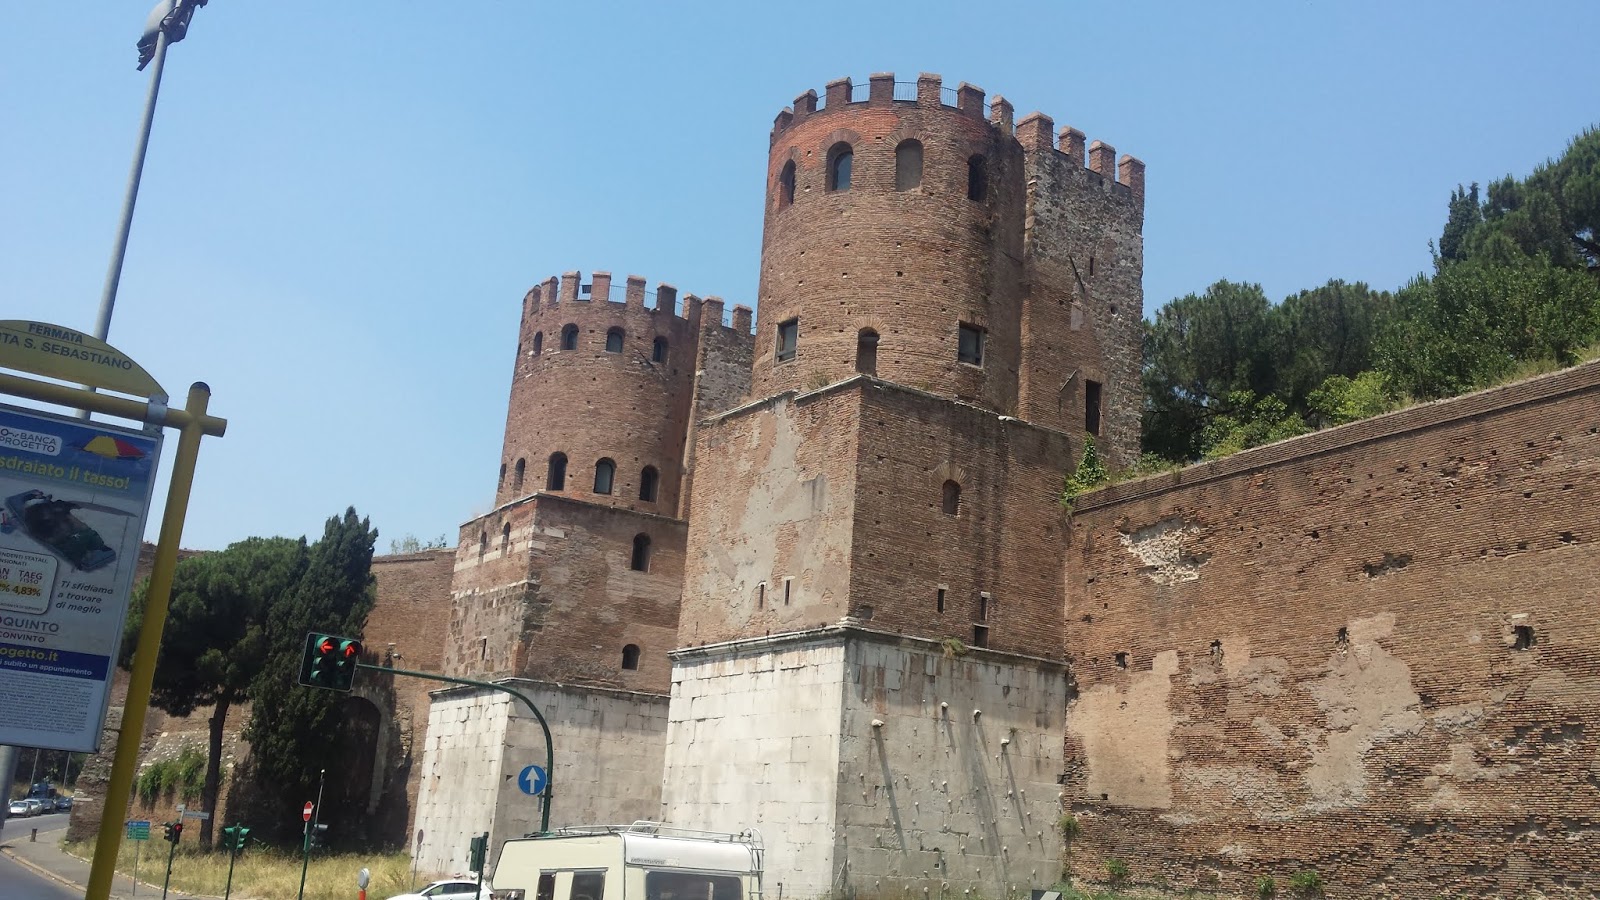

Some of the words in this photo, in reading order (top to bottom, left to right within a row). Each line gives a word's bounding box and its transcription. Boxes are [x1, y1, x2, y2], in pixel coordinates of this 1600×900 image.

[28, 323, 83, 344] FERMATA
[0, 332, 19, 346] TA
[24, 338, 36, 350] S.
[41, 341, 132, 370] SEBASTIANO
[0, 436, 55, 452] PROGETTO
[20, 432, 56, 445] BANCA
[69, 467, 80, 480] il
[83, 470, 130, 490] tasso!
[18, 570, 43, 581] TAEG
[12, 585, 41, 597] 4,83%
[61, 580, 70, 588] Ti
[71, 581, 114, 595] sfidiamo
[66, 592, 102, 603] trovare
[55, 601, 66, 609] di
[67, 603, 101, 614] meglio
[4, 660, 28, 668] subito
[39, 664, 92, 676] appuntamento
